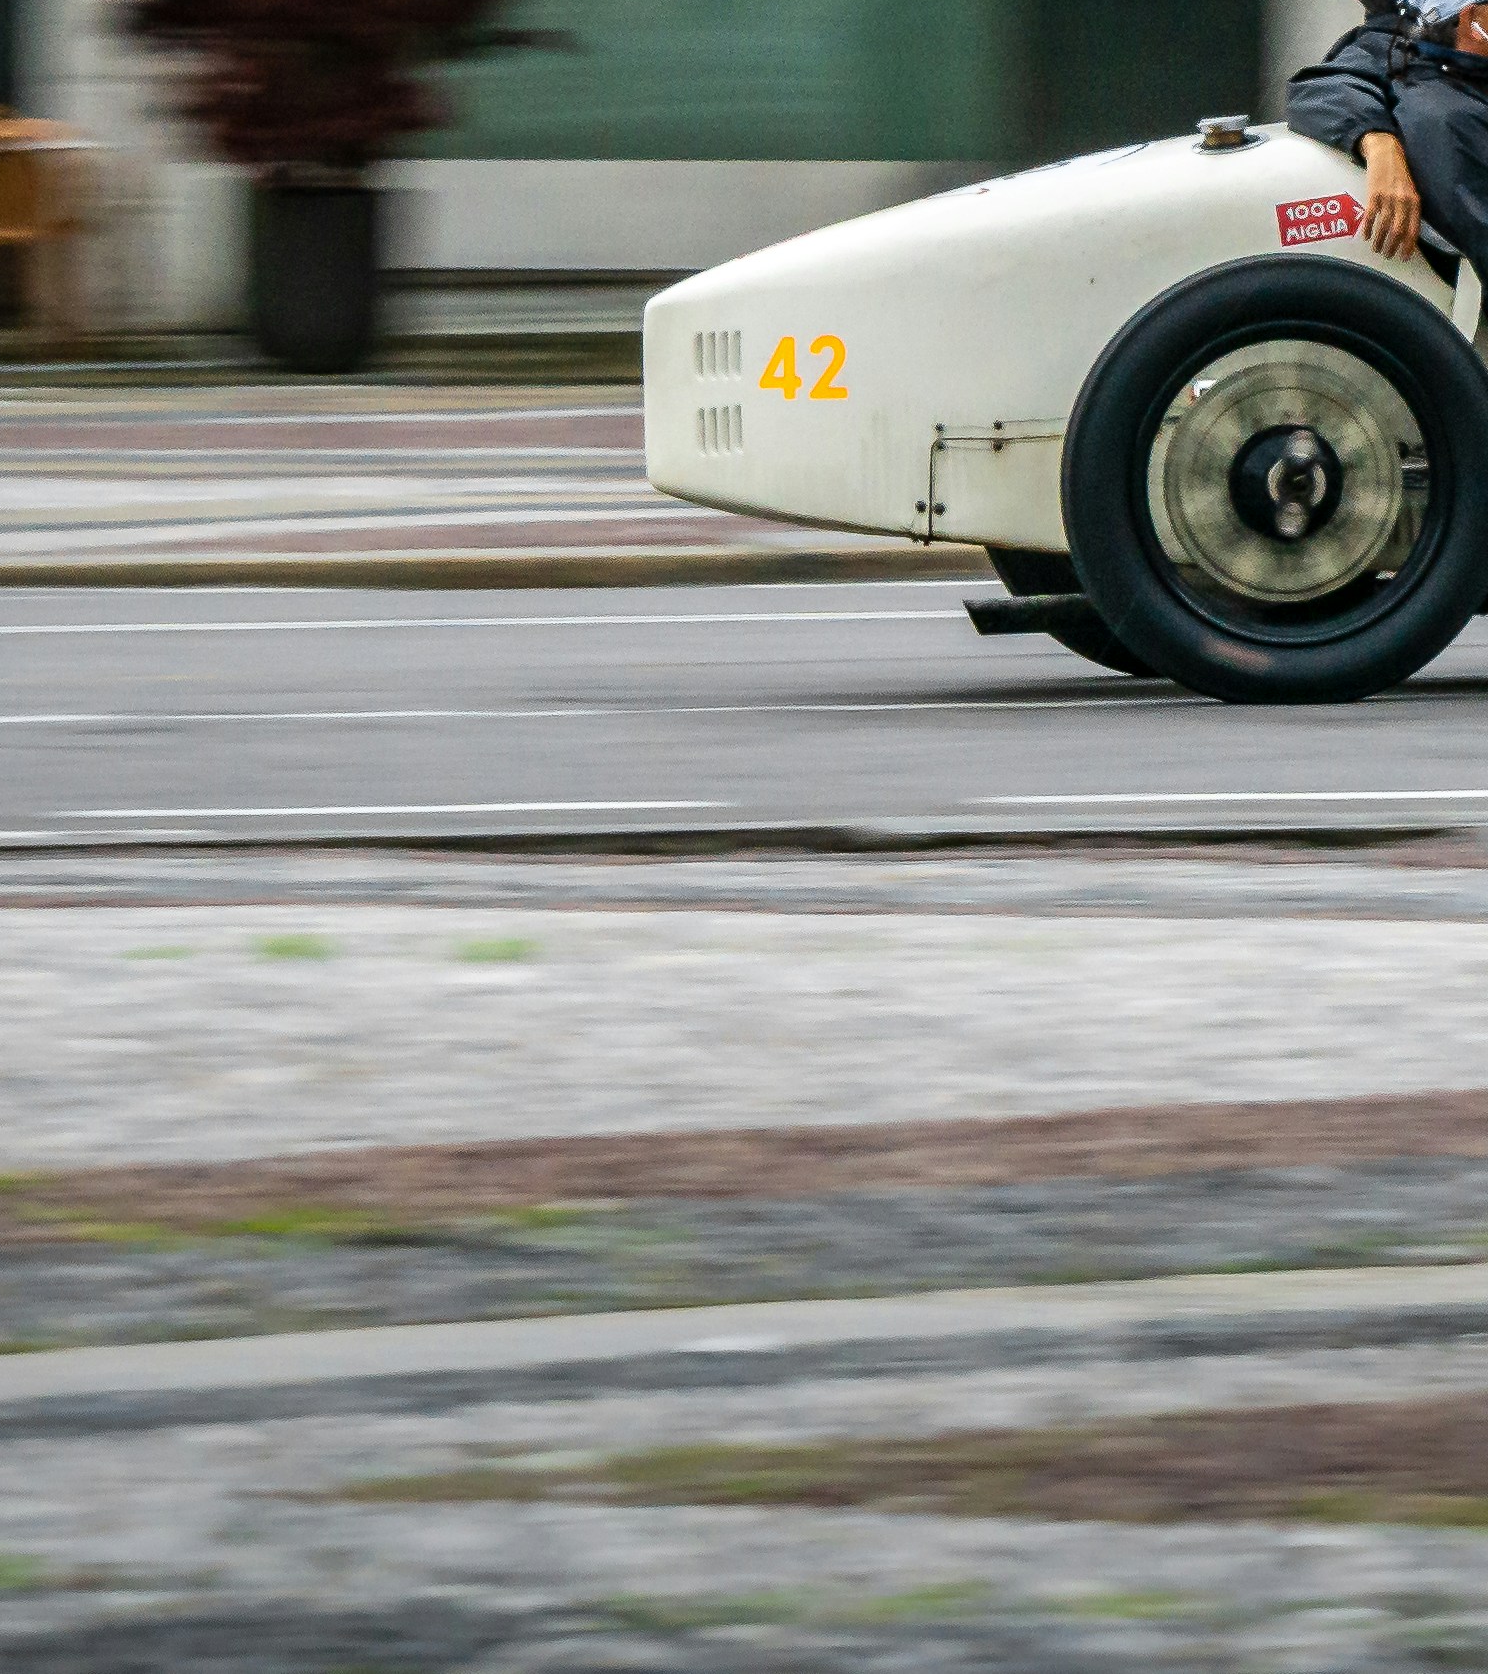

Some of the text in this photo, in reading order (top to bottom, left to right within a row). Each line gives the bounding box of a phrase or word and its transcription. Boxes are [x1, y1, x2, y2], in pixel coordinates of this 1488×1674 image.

[1286, 199, 1341, 220] 1000
[1286, 218, 1348, 242] MIGLIA
[759, 334, 849, 400] 42
